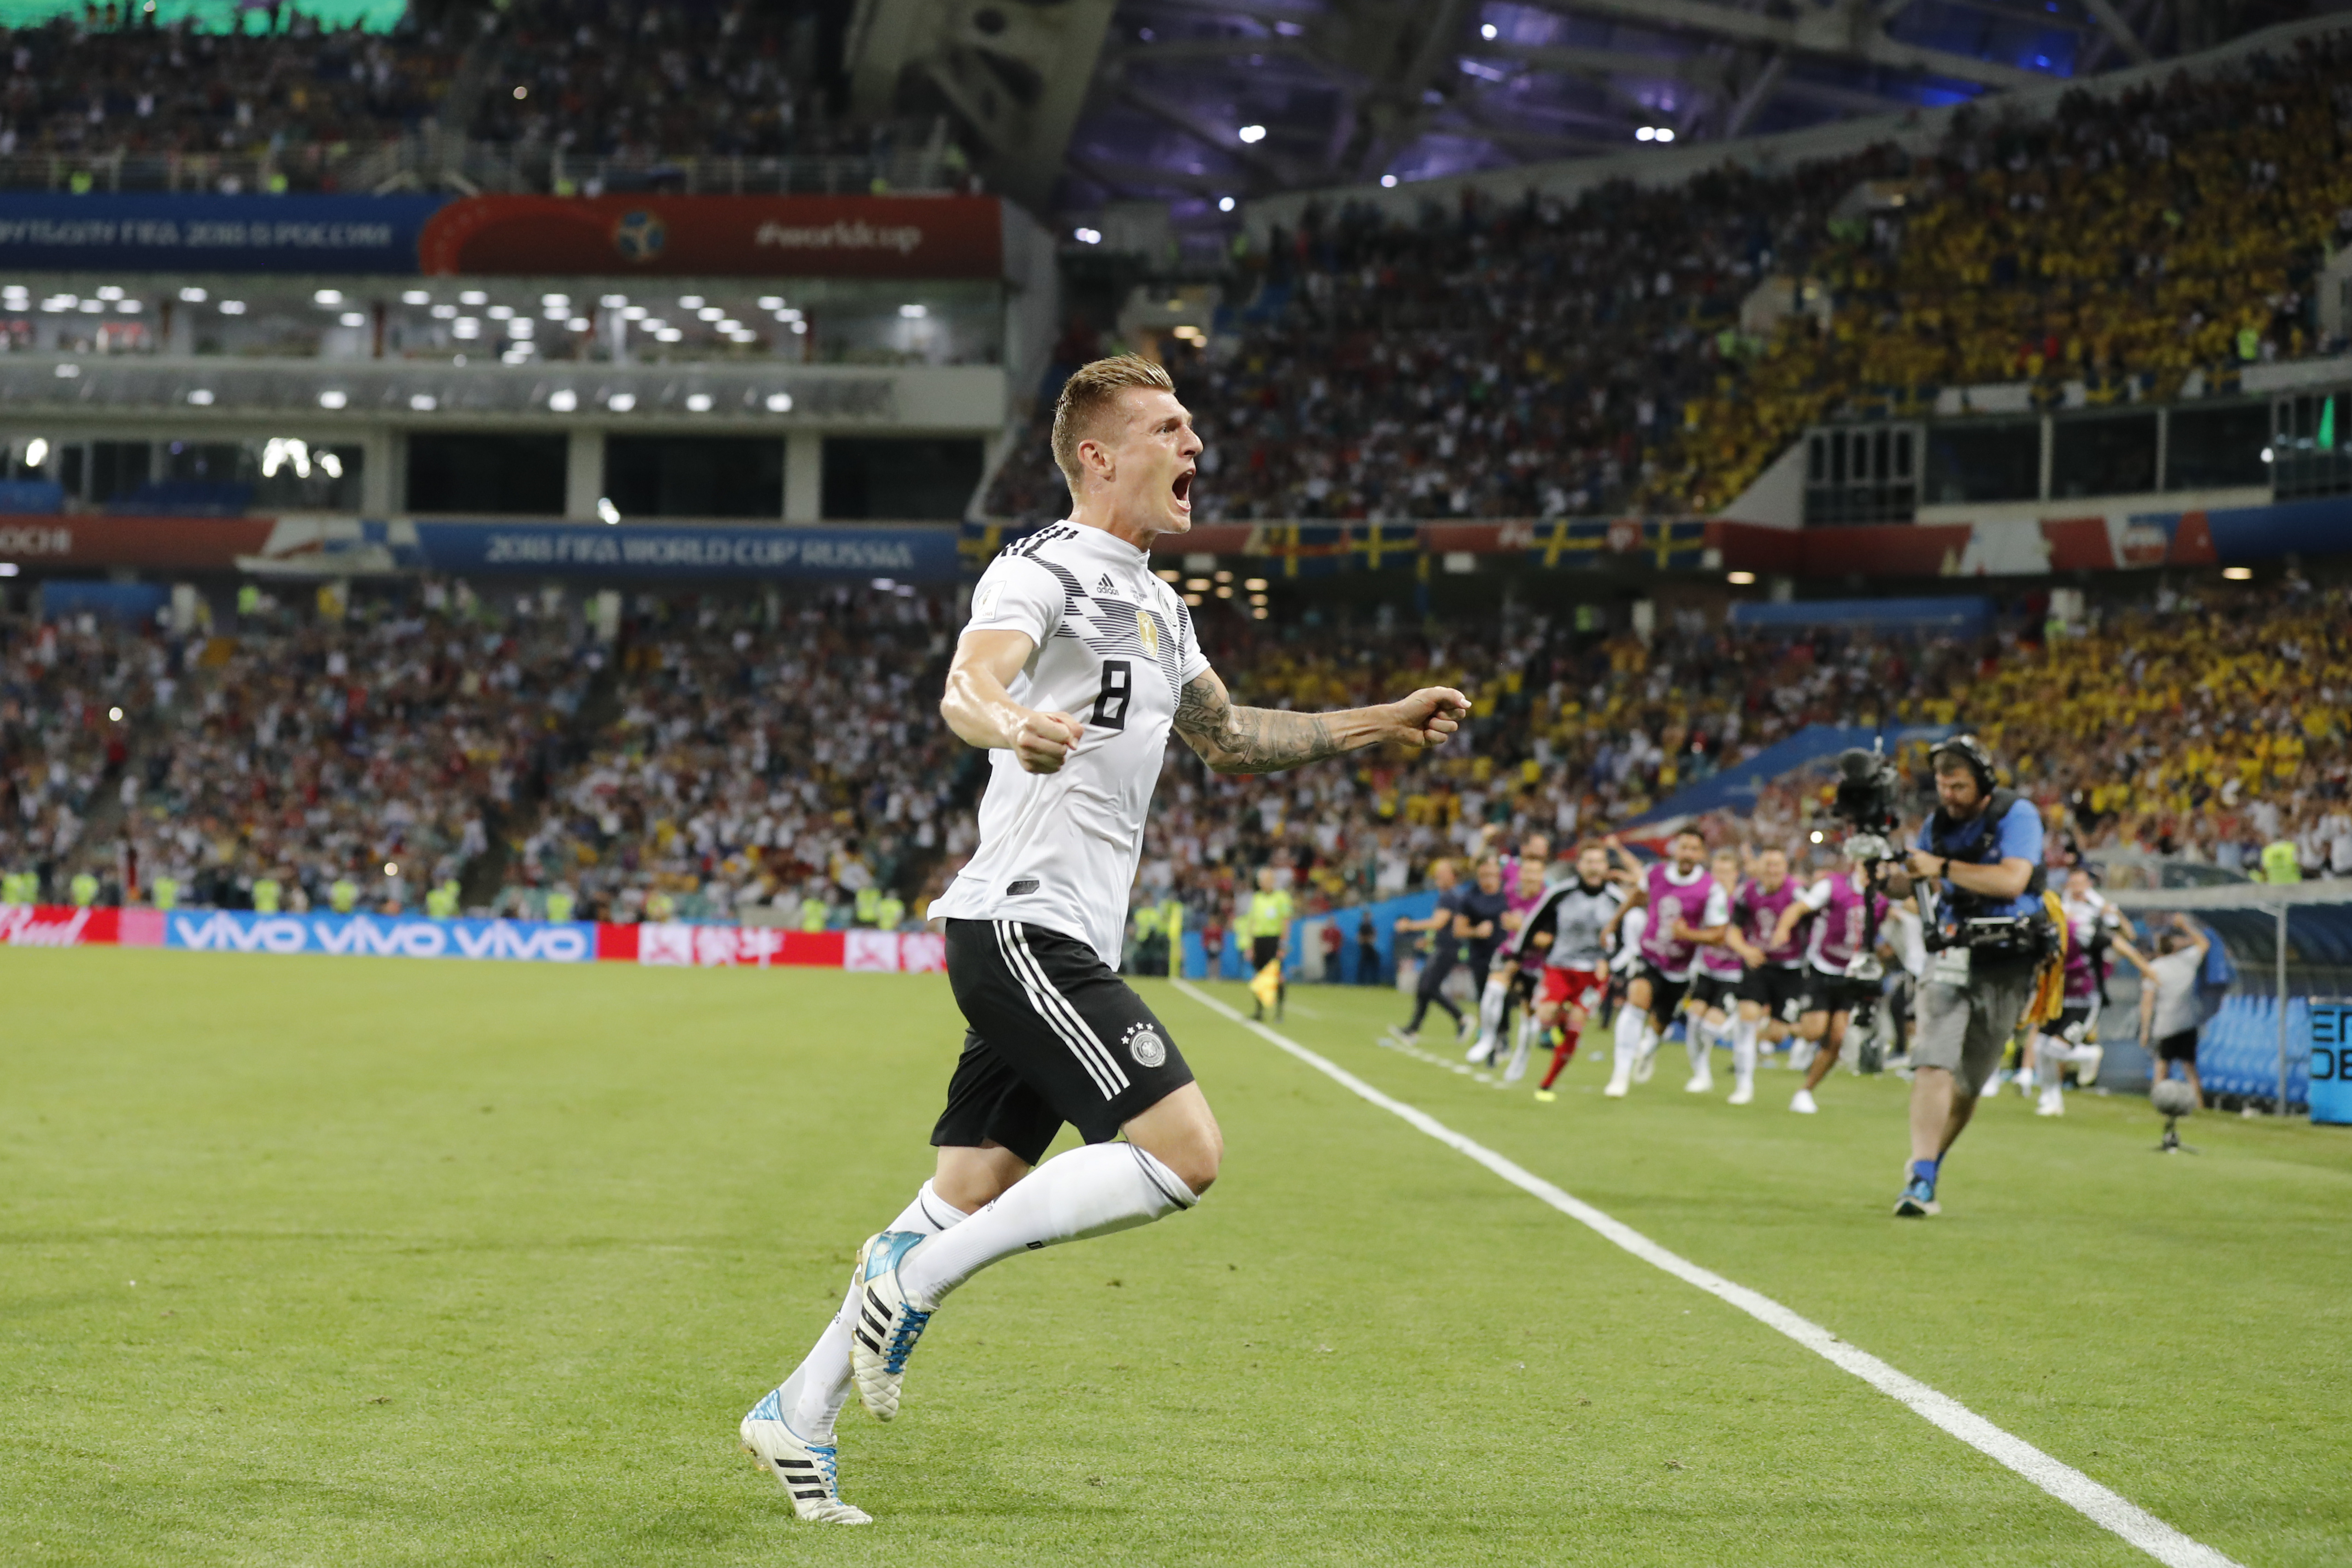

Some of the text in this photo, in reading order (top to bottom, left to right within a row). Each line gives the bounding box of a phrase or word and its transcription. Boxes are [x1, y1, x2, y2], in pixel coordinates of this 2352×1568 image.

[555, 534, 620, 564] FIFA
[622, 536, 730, 566] WORLD
[732, 538, 799, 566] CUP
[801, 539, 913, 569] RUSSIA
[1097, 586, 1119, 596] adidas
[1090, 660, 1132, 730] 8
